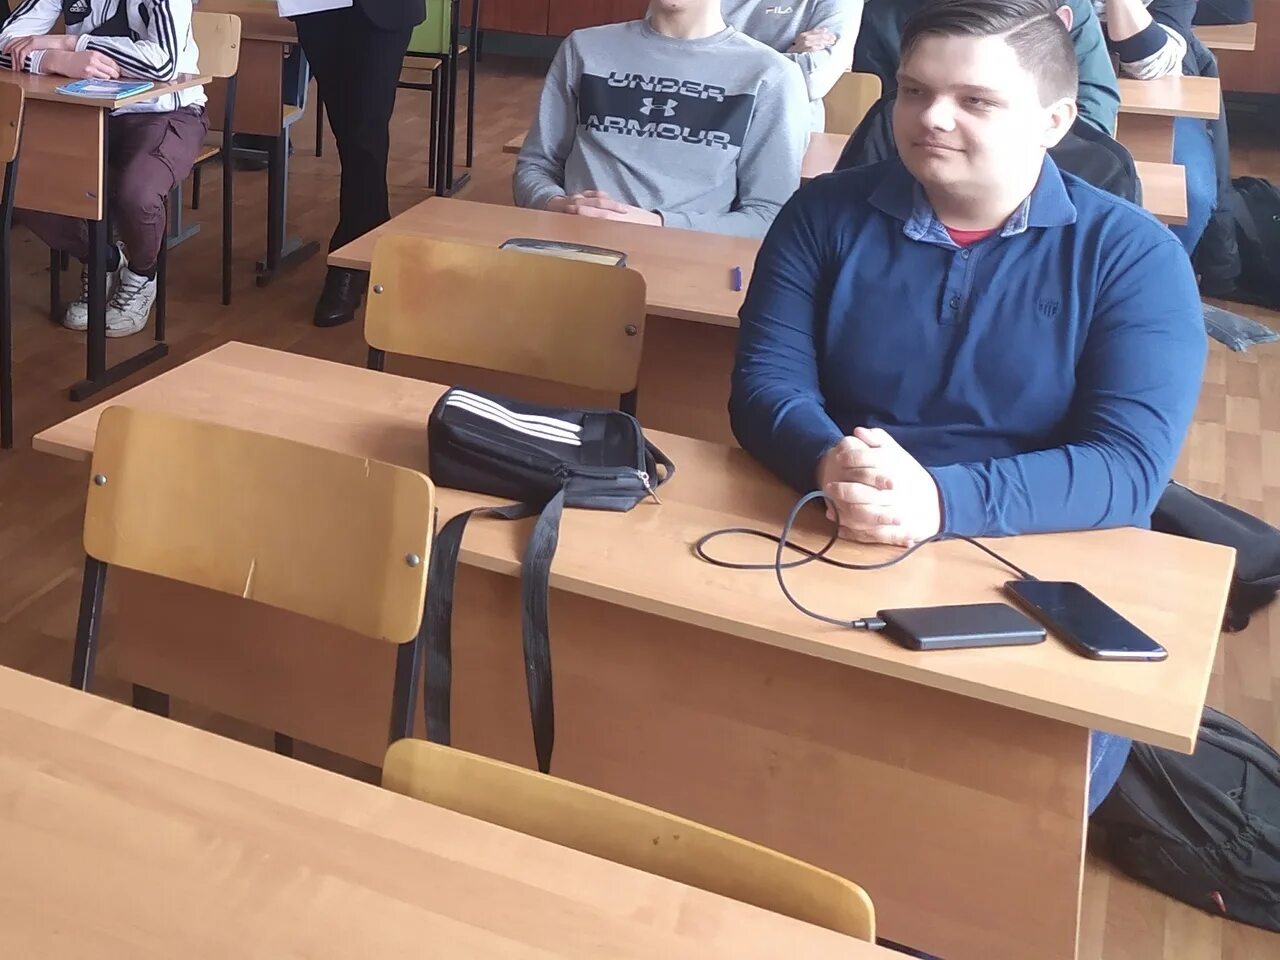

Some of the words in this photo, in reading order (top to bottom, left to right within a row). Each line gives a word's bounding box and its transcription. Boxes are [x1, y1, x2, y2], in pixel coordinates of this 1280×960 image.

[765, 6, 794, 15] FILA
[607, 72, 726, 103] UNDER
[585, 114, 731, 150] ARMOUR
